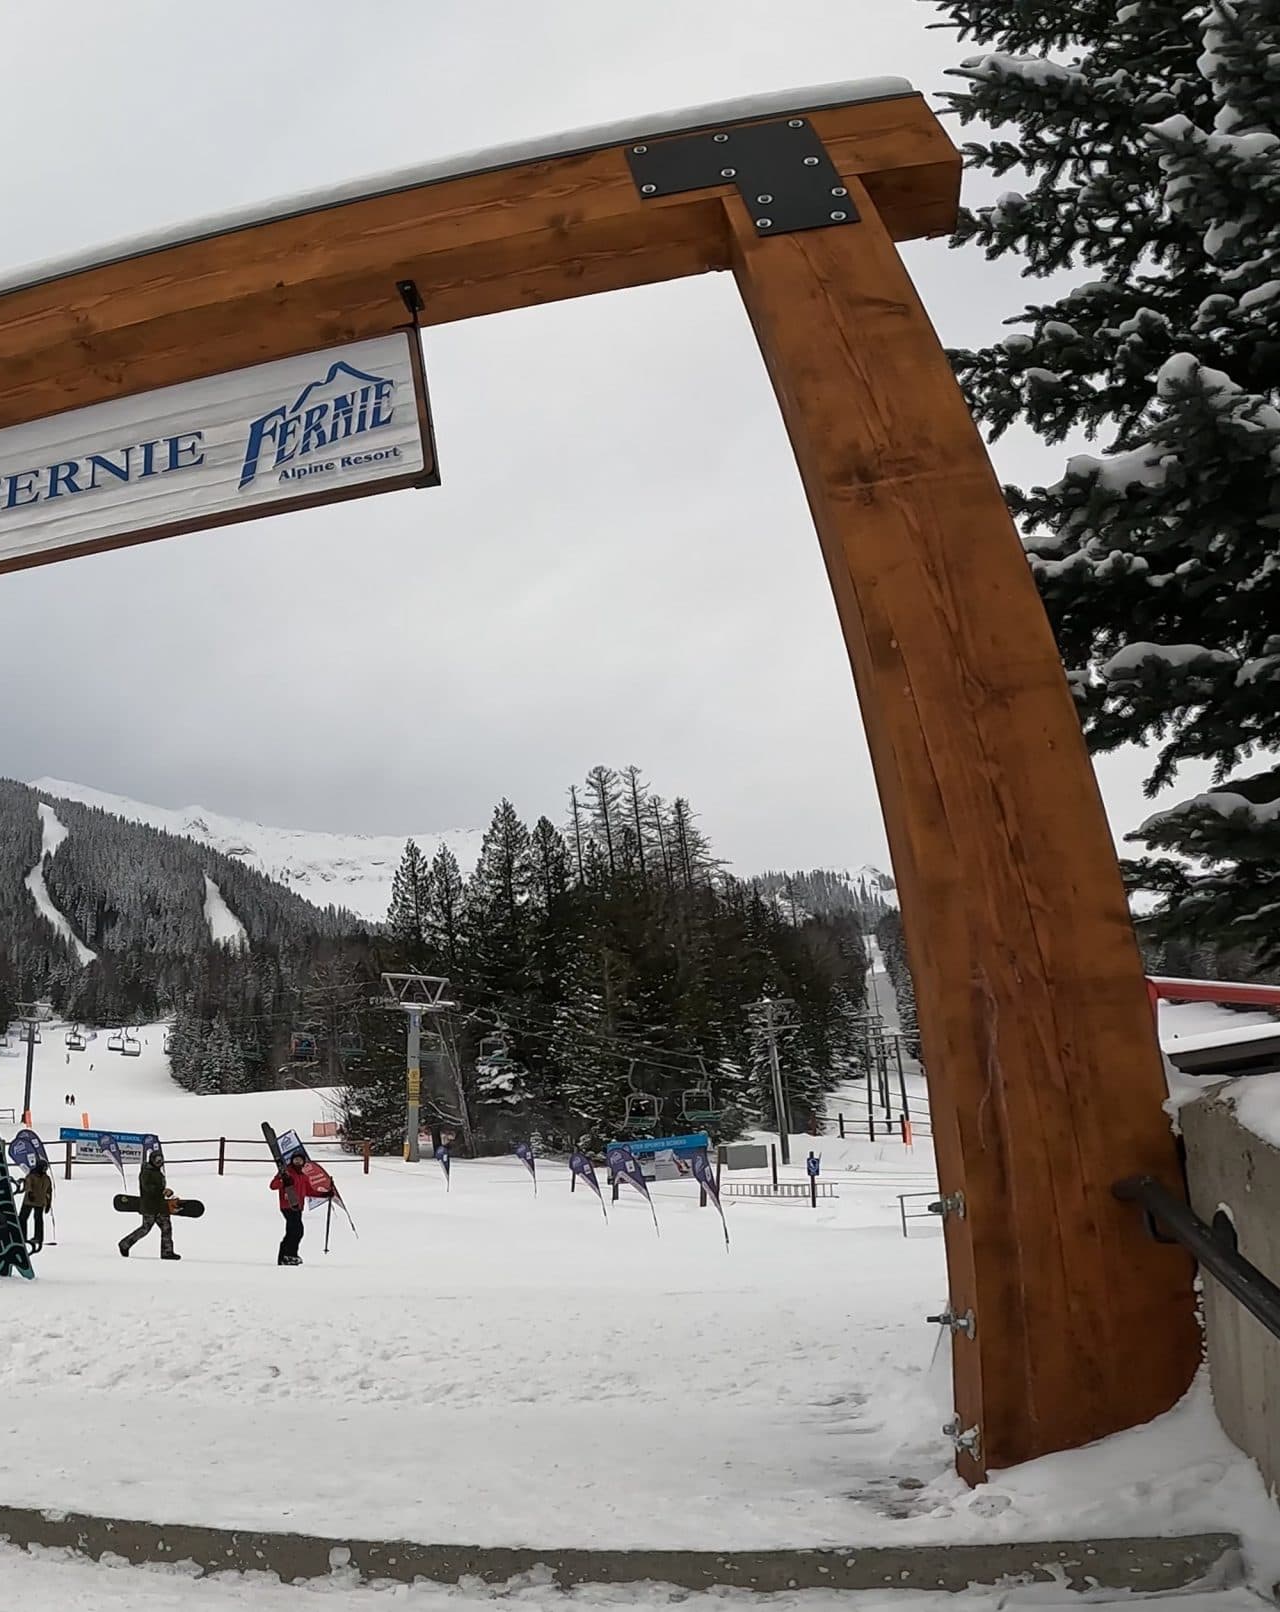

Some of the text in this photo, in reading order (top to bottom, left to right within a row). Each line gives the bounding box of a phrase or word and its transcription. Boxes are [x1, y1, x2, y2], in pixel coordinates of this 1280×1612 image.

[238, 379, 394, 490] FERNIE
[278, 446, 402, 482] Alpine Resort
